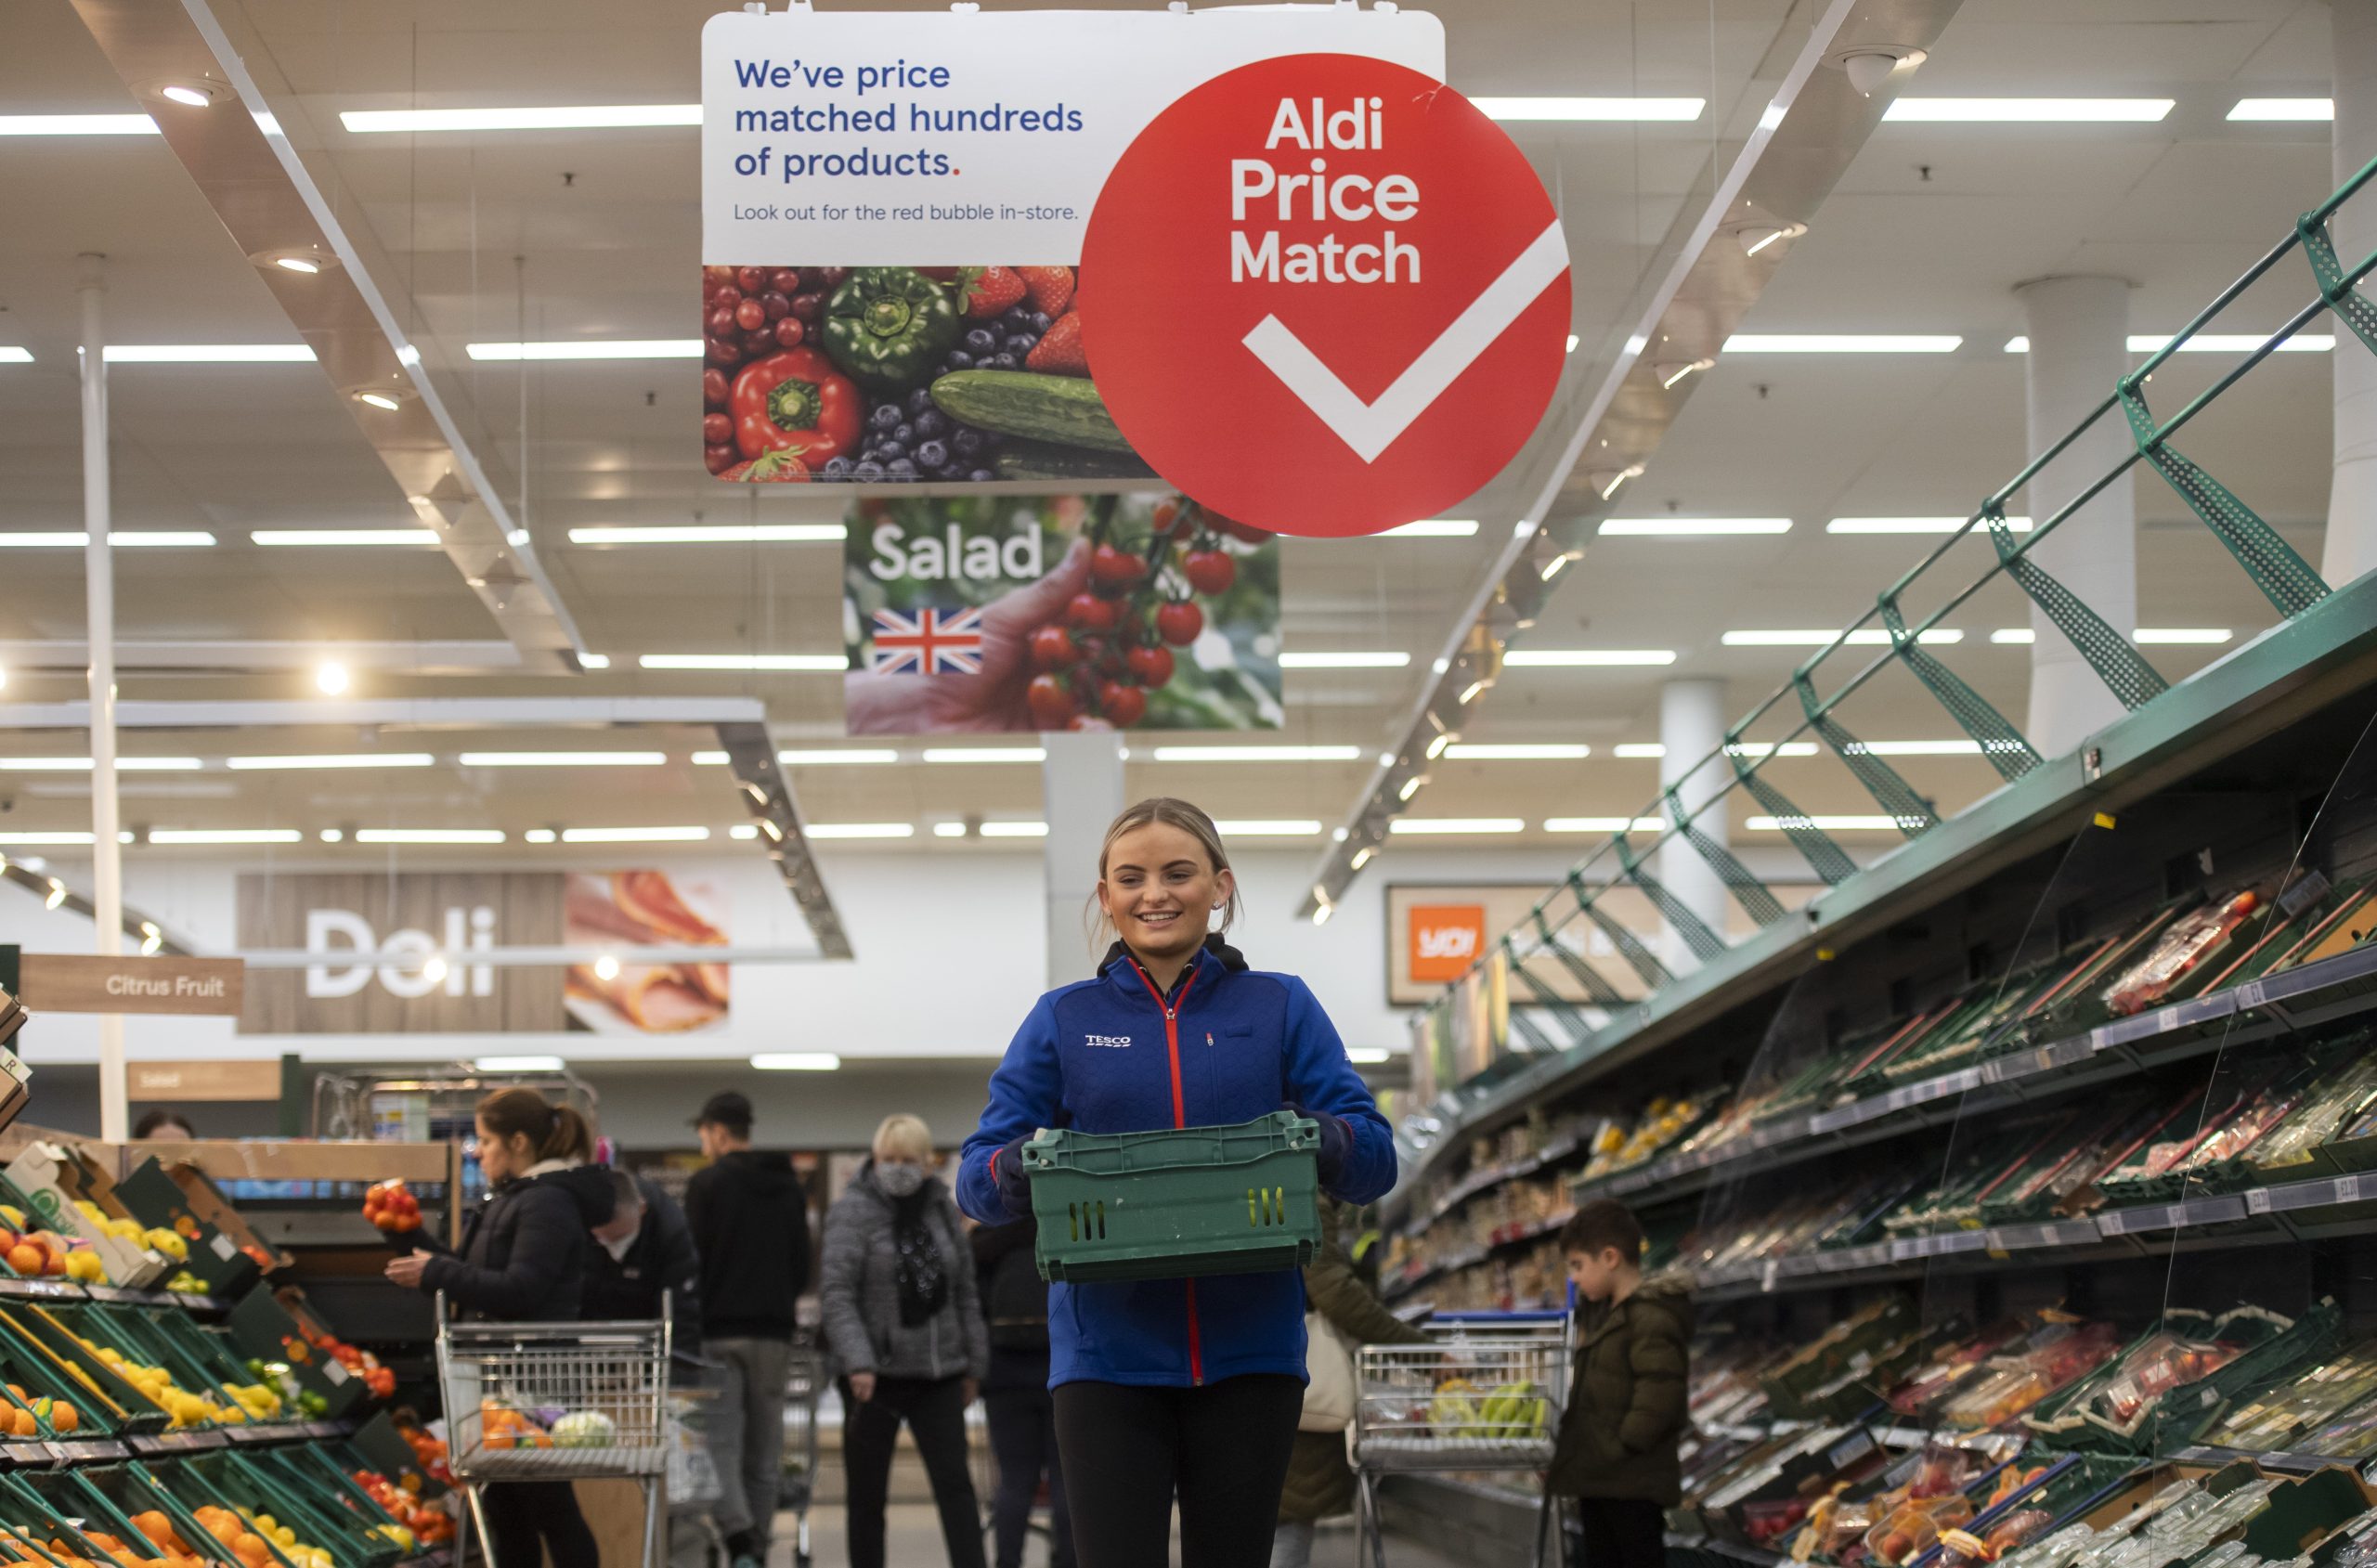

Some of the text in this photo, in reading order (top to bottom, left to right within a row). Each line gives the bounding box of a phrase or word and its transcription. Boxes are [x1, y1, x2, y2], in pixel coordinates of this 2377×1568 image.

[734, 58, 950, 97] We've price
[736, 102, 1084, 133] matched hundreds
[1265, 96, 1383, 150] Aldi
[734, 146, 960, 184] of products.
[1231, 157, 1420, 222] Price
[734, 203, 1079, 221] Look out for the red bubble in-store.
[1230, 230, 1421, 284] Match
[868, 522, 1044, 581] Salad
[305, 905, 496, 998] Deli
[106, 974, 225, 997] Citrus Fruit
[1085, 1034, 1132, 1045] TESCO
